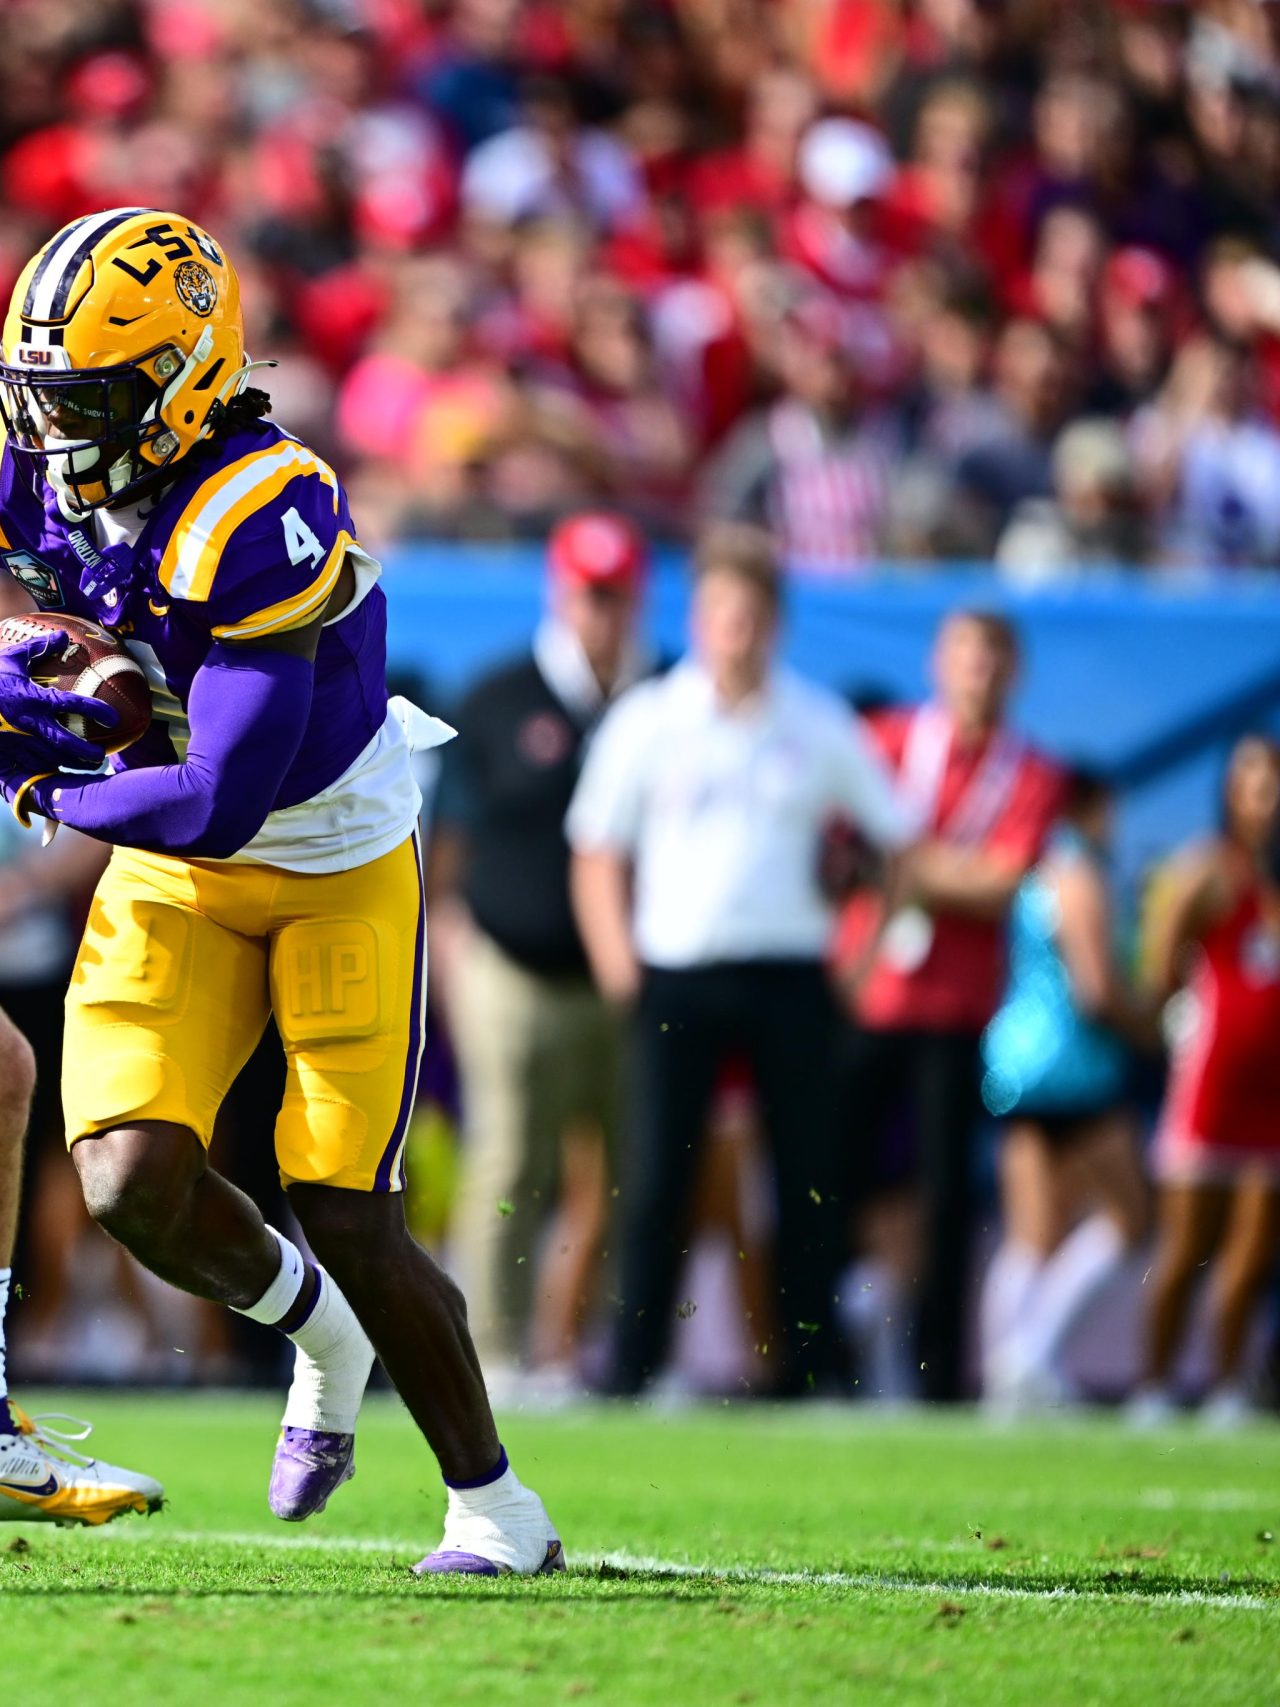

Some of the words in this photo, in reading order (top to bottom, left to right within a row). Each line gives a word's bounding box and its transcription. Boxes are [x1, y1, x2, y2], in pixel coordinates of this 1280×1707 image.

[111, 224, 223, 287] LSU
[19, 349, 52, 365] LSU
[83, 408, 115, 419] SURVIE
[67, 530, 103, 569] NXTRND
[280, 506, 327, 570] 4
[291, 944, 368, 1017] HP
